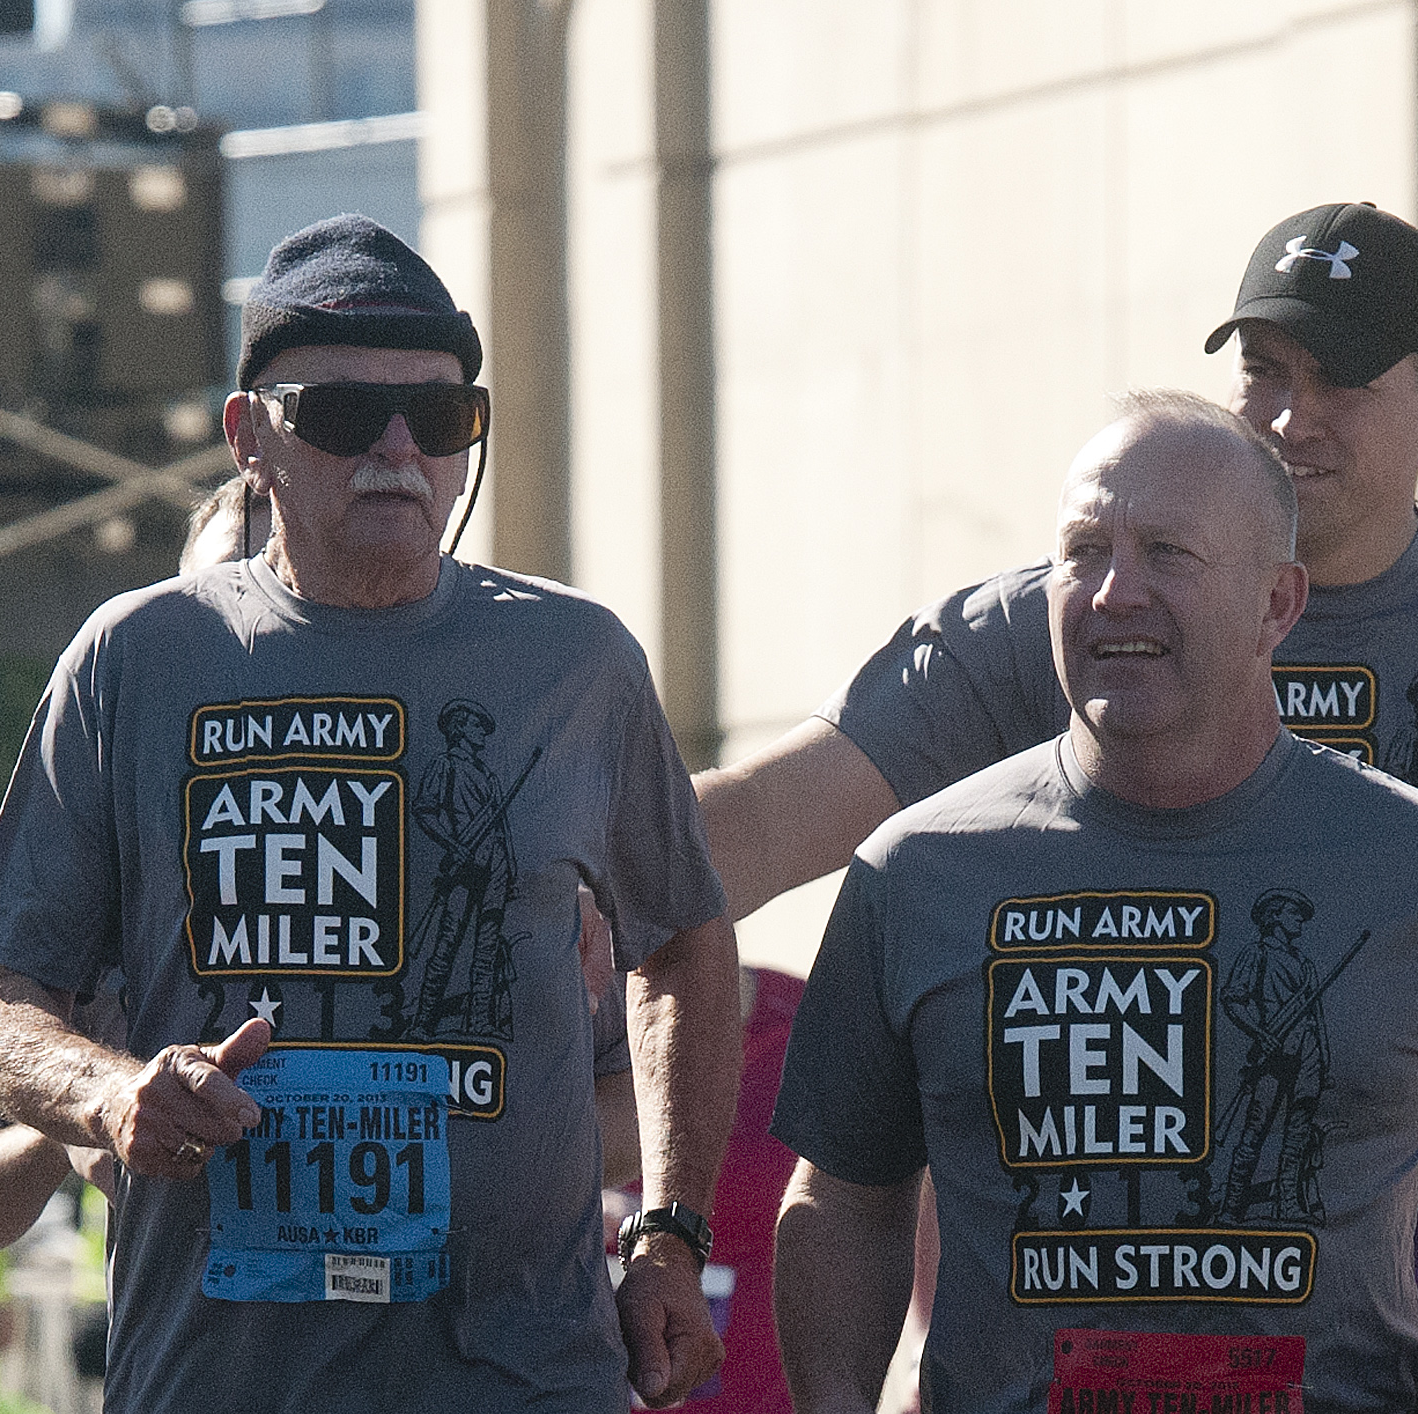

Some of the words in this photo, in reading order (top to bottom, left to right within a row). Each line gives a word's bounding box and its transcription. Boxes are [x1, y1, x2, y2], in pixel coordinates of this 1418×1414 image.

[203, 714, 272, 755] RUN
[283, 711, 393, 748] ARMY
[200, 776, 392, 830] ARMY
[199, 833, 377, 909] TEN
[208, 914, 384, 966] MILER
[1004, 906, 1081, 941] RUN
[1092, 905, 1204, 939] ARMY
[1004, 967, 1201, 1018] ARMY
[369, 1061, 428, 1083] 11191
[1004, 1023, 1183, 1098] TEN
[265, 1093, 330, 1104] OCTOBER
[296, 1106, 440, 1140] TEN-MILER
[1018, 1105, 1190, 1157] MILER
[224, 1139, 425, 1215] 11191
[277, 1225, 320, 1245] AUSA
[343, 1225, 379, 1246] KBR
[1024, 1245, 1098, 1291] RUN
[1115, 1244, 1301, 1291] STRONG
[1228, 1346, 1277, 1369] 5517
